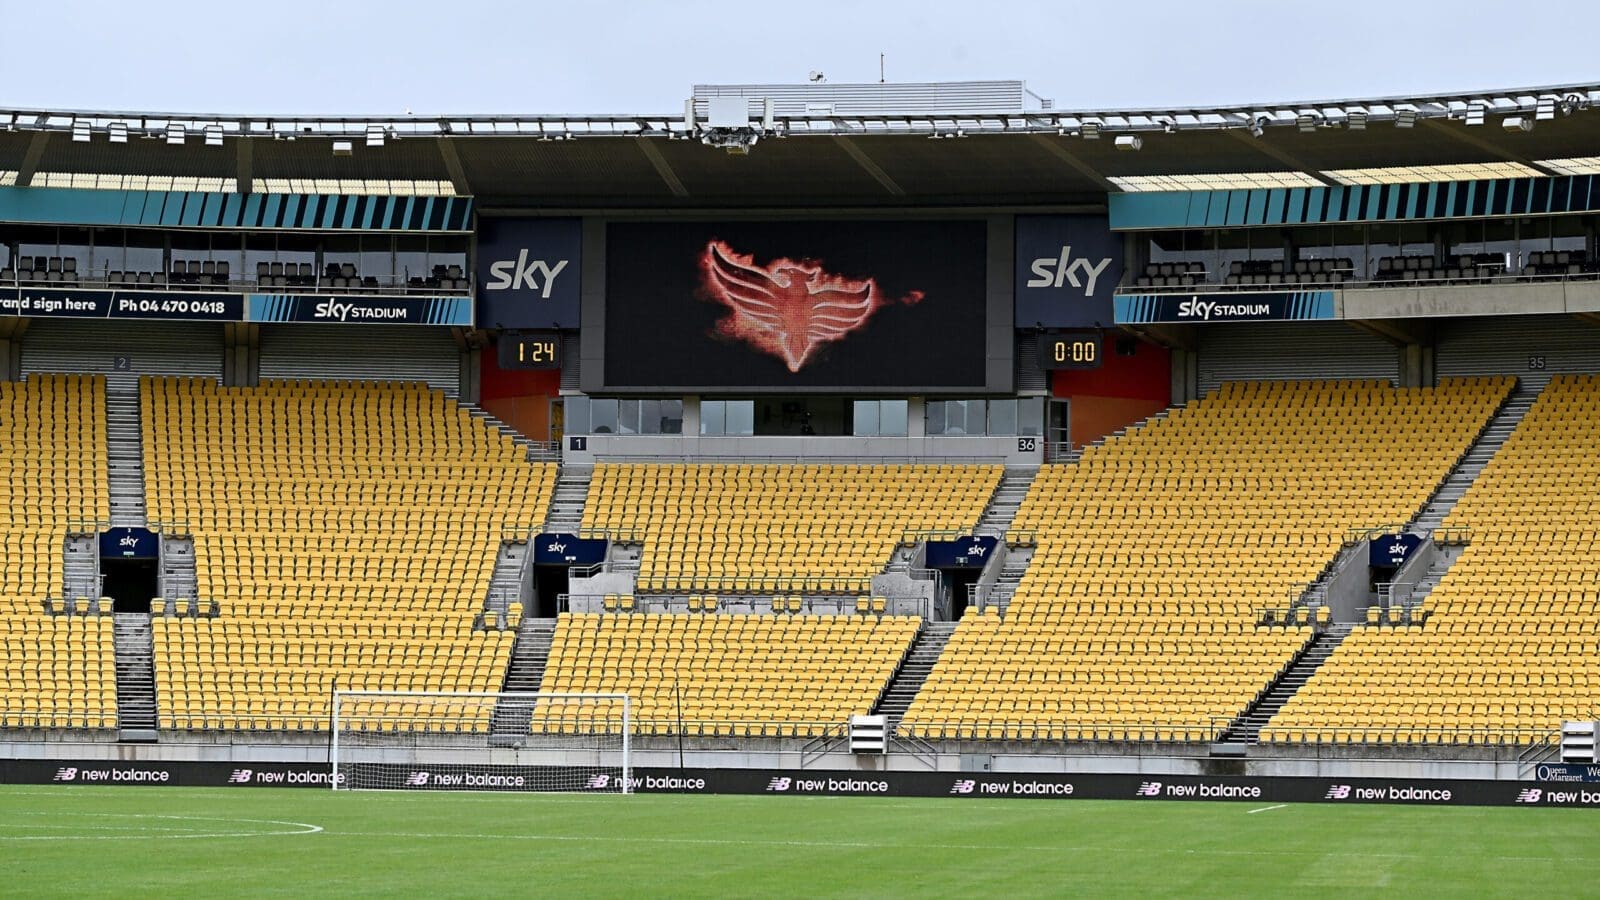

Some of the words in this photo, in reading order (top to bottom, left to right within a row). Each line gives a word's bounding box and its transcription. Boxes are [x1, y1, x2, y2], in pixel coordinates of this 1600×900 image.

[486, 248, 568, 298] sky
[1027, 246, 1112, 296] sky
[0, 296, 30, 308] and
[33, 297, 62, 312] sign
[65, 298, 96, 310] here
[119, 299, 138, 311] Ph
[140, 300, 159, 311] 04
[161, 301, 188, 312] 470
[190, 301, 225, 313] 0418
[314, 298, 353, 321] sky
[351, 307, 407, 318] STADIUM
[1178, 296, 1216, 320] sky
[1214, 304, 1270, 315] STADIUM
[1055, 342, 1095, 361] 0:00
[118, 358, 126, 368] 2
[1529, 357, 1545, 368] 35
[1019, 439, 1035, 450] 36
[119, 535, 139, 548] sky
[547, 541, 567, 554] sky
[967, 544, 987, 557] sky
[1388, 542, 1409, 556] sky
[82, 769, 110, 780] new
[112, 768, 169, 781] balance
[256, 772, 285, 782] new
[434, 774, 462, 785] new
[465, 772, 524, 786] balance
[646, 775, 705, 789] balance
[796, 780, 826, 791] new
[828, 777, 889, 792] balance
[980, 782, 1010, 793] new
[1013, 780, 1074, 794] balance
[1166, 785, 1197, 796] new
[1200, 783, 1261, 797] balance
[1355, 788, 1386, 799] new
[1389, 786, 1452, 800] balance
[1547, 791, 1578, 803] new
